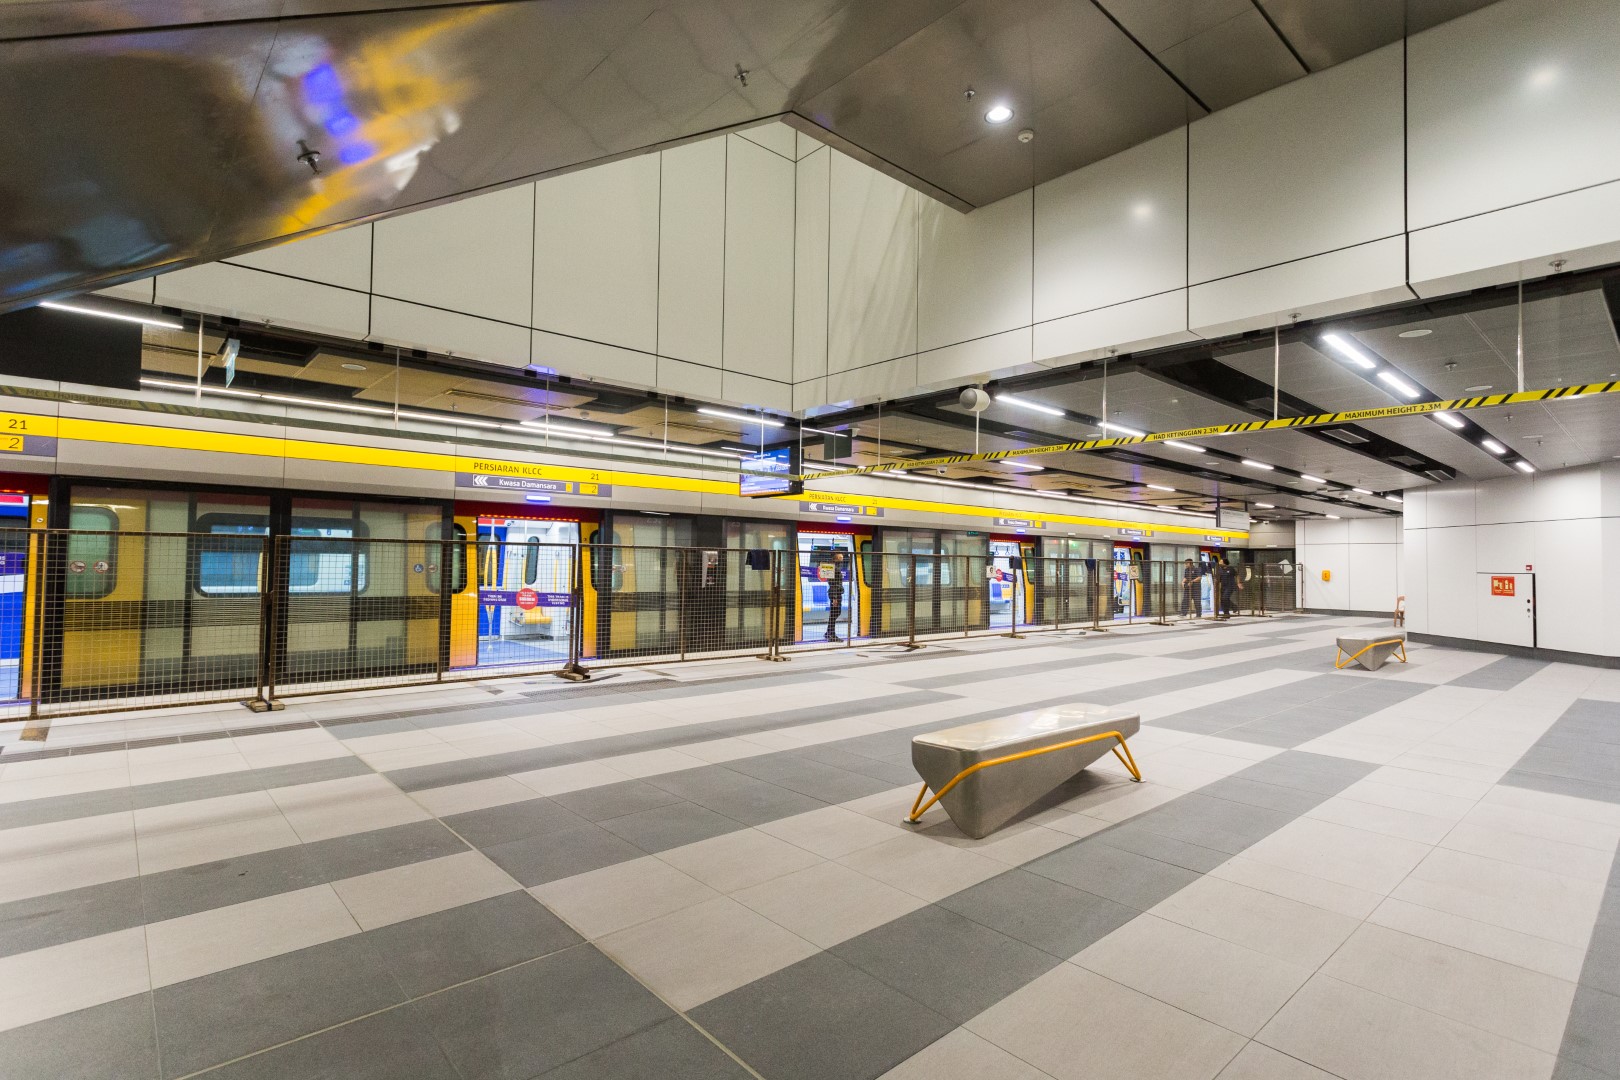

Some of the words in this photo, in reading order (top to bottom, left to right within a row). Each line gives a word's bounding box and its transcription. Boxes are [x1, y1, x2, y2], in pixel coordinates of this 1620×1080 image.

[1344, 409, 1385, 419] MAXIMUM
[1386, 405, 1418, 415] HEIGHT
[1419, 403, 1441, 412] 2.3M
[8, 418, 27, 430] 21
[1166, 429, 1202, 439] KETINGGIAN
[9, 437, 20, 449] 2
[473, 462, 520, 474] PERSIARAN
[522, 466, 542, 476] KLCC
[590, 473, 600, 481] 21
[499, 479, 520, 488] Kwasa
[521, 480, 557, 490] Damansara
[591, 485, 597, 493] 2
